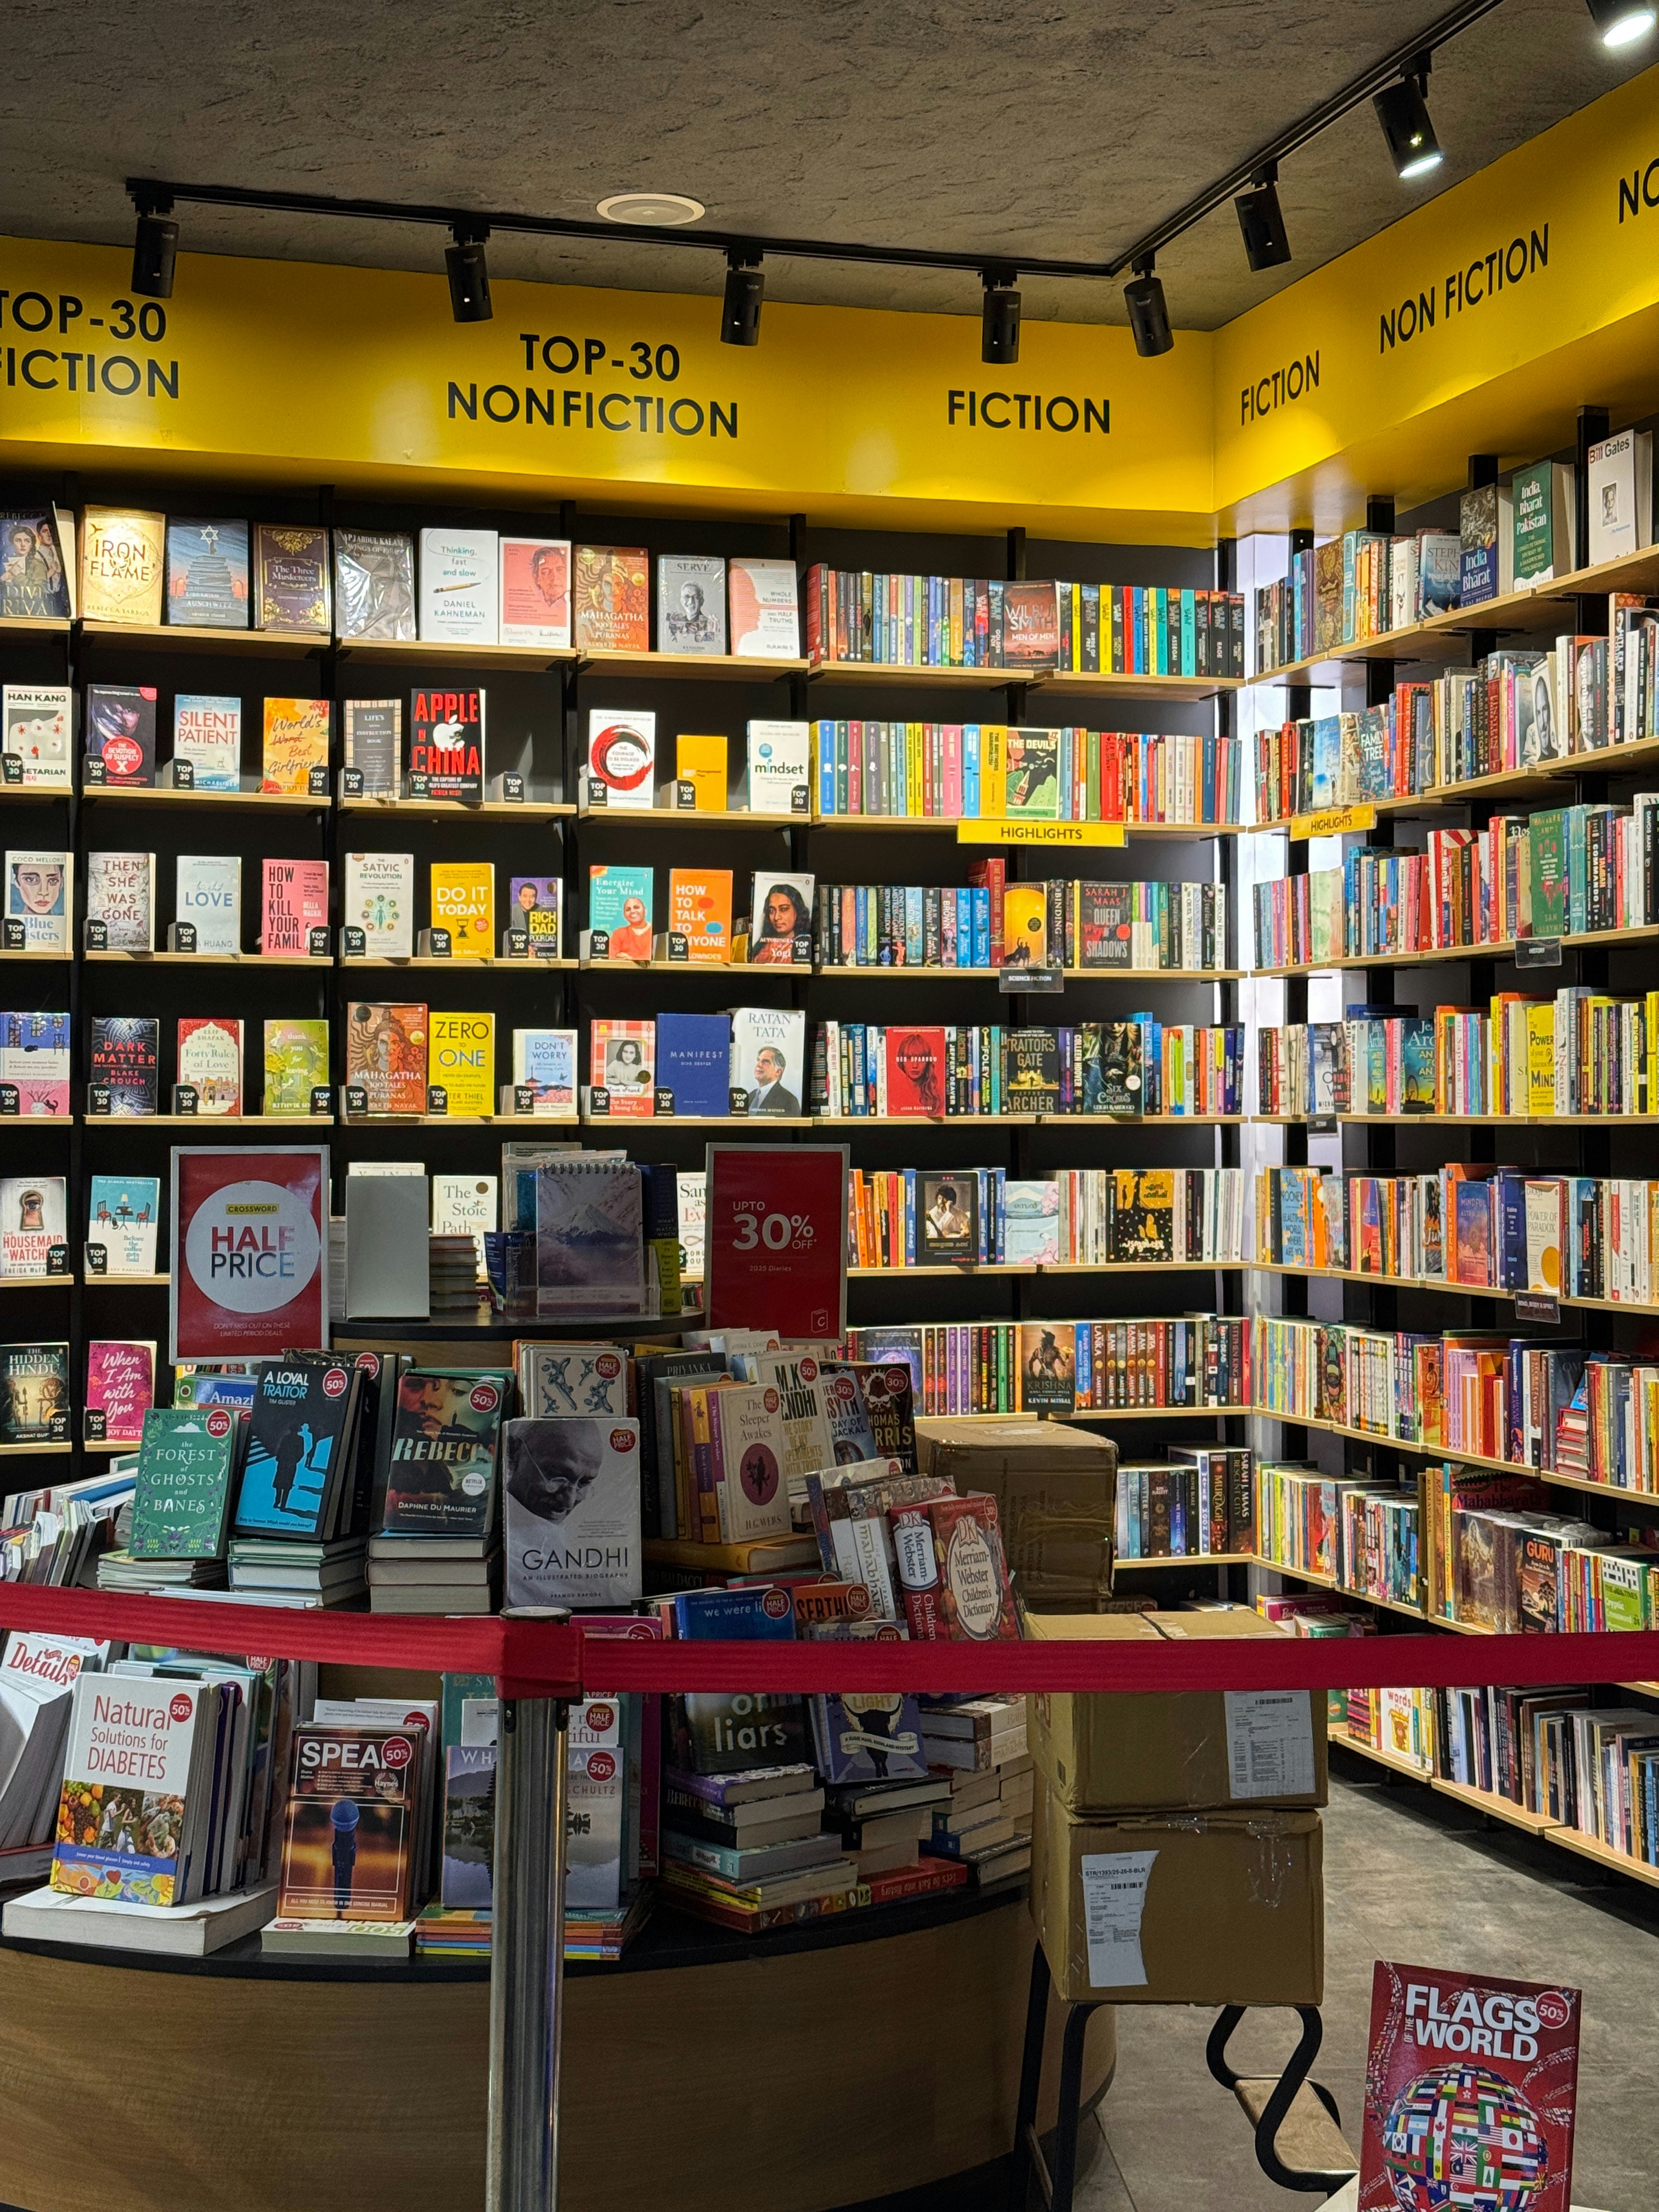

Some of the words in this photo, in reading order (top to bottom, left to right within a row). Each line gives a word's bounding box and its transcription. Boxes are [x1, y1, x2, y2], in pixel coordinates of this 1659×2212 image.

[1380, 286, 1435, 354] NON
[1446, 222, 1549, 319] FICTION
[520, 333, 680, 382] TOP-30
[0, 349, 179, 399] ICTION
[1241, 349, 1320, 427] FICTION
[448, 381, 737, 438] NONFICTION
[948, 390, 1110, 434] FICTION
[1588, 449, 1603, 465] Bill
[1604, 437, 1630, 459] Gates
[1520, 495, 1543, 516] Bharat
[1516, 513, 1547, 536] Pakistan
[95, 539, 145, 562] IRON
[1465, 549, 1487, 571] India
[91, 561, 150, 582] FLAME
[274, 565, 289, 573] The
[290, 566, 315, 575] Three
[272, 573, 317, 583] Musketeers
[1463, 568, 1491, 592] Bharat
[443, 600, 476, 608] DANIEL
[434, 610, 486, 618] KAHNEMAN
[580, 611, 644, 622] MAHAGATHA
[8, 693, 32, 702] HAN
[35, 693, 66, 702] KANG
[414, 693, 478, 723] APPLE
[179, 711, 238, 729] SILENT
[272, 714, 323, 732] World's
[178, 729, 238, 745] PATIENT
[1007, 738, 1025, 748] THE
[1026, 738, 1056, 749] DEVILS
[1361, 730, 1383, 747] FAMILY
[289, 744, 313, 757] Best
[1364, 746, 1383, 761] TREE
[116, 761, 128, 773] X
[412, 746, 480, 776] CHINA
[755, 759, 804, 774] mindset
[1311, 814, 1352, 832] HIGHLIGHTS
[1000, 827, 1082, 840] HIGHLIGHTS
[103, 860, 140, 872] THEN
[362, 864, 399, 872] SATVIC
[269, 866, 294, 883] HOW
[109, 877, 137, 888] SHE
[596, 878, 634, 888] Energize
[676, 885, 707, 895] HOW
[106, 893, 137, 904] WAS
[269, 883, 283, 899] TO
[436, 887, 466, 902] DO
[471, 886, 488, 901] IT
[596, 887, 617, 895] Your
[185, 892, 233, 907] LOVE
[676, 898, 692, 908] TO
[1093, 897, 1121, 906] MAAS
[102, 909, 140, 921] GONE
[269, 900, 293, 916] KILL
[437, 904, 487, 916] TODAY
[676, 910, 706, 921] TALK
[24, 916, 54, 930] Blue
[529, 911, 556, 923] RICH
[1094, 909, 1120, 924] QUEEN
[269, 917, 299, 933] YOUR
[529, 922, 556, 935] DAD
[26, 928, 59, 941] isters
[268, 933, 302, 950] FAMIL
[1086, 940, 1127, 958] SHADOWS
[748, 1012, 792, 1025] RATAN
[435, 1021, 489, 1040] ZERO
[753, 1026, 786, 1039] TATA
[104, 1042, 146, 1052] DARK
[534, 1041, 565, 1050] DON'T
[93, 1053, 156, 1064] MATTER
[439, 1049, 486, 1067] ONE
[532, 1051, 567, 1059] WORRY
[670, 1051, 724, 1059] MANIFEST
[1017, 1053, 1042, 1066] GATE
[354, 1071, 421, 1081] MAHAGATHA
[1007, 1097, 1054, 1111] ARCHER
[444, 1184, 471, 1199] The
[228, 1205, 277, 1214] CROSSWORD
[452, 1203, 487, 1216] Stoic
[732, 1201, 765, 1211] UPTO
[442, 1221, 471, 1234] Path
[732, 1214, 814, 1250] 30%
[3, 1235, 63, 1248] HOUSEMAID
[211, 1226, 295, 1252] HALF
[211, 1252, 295, 1278] PRICE
[9, 1353, 60, 1364] HIDDEN
[101, 1351, 142, 1370] When
[9, 1364, 60, 1376] HINDU
[264, 1371, 274, 1384] A
[275, 1372, 309, 1386] LOYAL
[103, 1384, 136, 1400] with
[263, 1384, 308, 1399] TRAITOR
[745, 1398, 762, 1410] The
[106, 1401, 134, 1423] You
[740, 1413, 771, 1427] Sleeper
[832, 1419, 847, 1429] DAY
[849, 1418, 861, 1427] OF
[740, 1428, 772, 1441] Awakes
[832, 1424, 868, 1437] JACKAL
[156, 1449, 216, 1465] FOREST
[392, 1437, 483, 1462] REBECC
[150, 1474, 215, 1486] GHOSTS
[154, 1498, 206, 1514] BANES
[398, 1502, 429, 1511] DAPHNE
[443, 1505, 477, 1514] MAURIER
[522, 1547, 628, 1571] GANDHI
[955, 1549, 989, 1568] Merriam-
[1526, 1541, 1554, 1563] GURU
[957, 1567, 988, 1585] Webster
[962, 1587, 992, 1604] Children's
[704, 1608, 719, 1618] we
[724, 1604, 751, 1616] were
[963, 1602, 995, 1617] Dictionary
[93, 1695, 172, 1731] Natural
[91, 1727, 146, 1748] Solutions
[151, 1733, 168, 1752] for
[714, 1717, 786, 1752] liars
[300, 1741, 402, 1770] SPEA
[386, 1748, 408, 1761] 50%
[87, 1746, 166, 1780] DIABETES
[1406, 1984, 1541, 2034] FLAGS
[1538, 2005, 1564, 2021] 50%
[1404, 2015, 1414, 2031] THE
[1403, 2031, 1414, 2043] OF
[1415, 2018, 1538, 2062] WORLD
